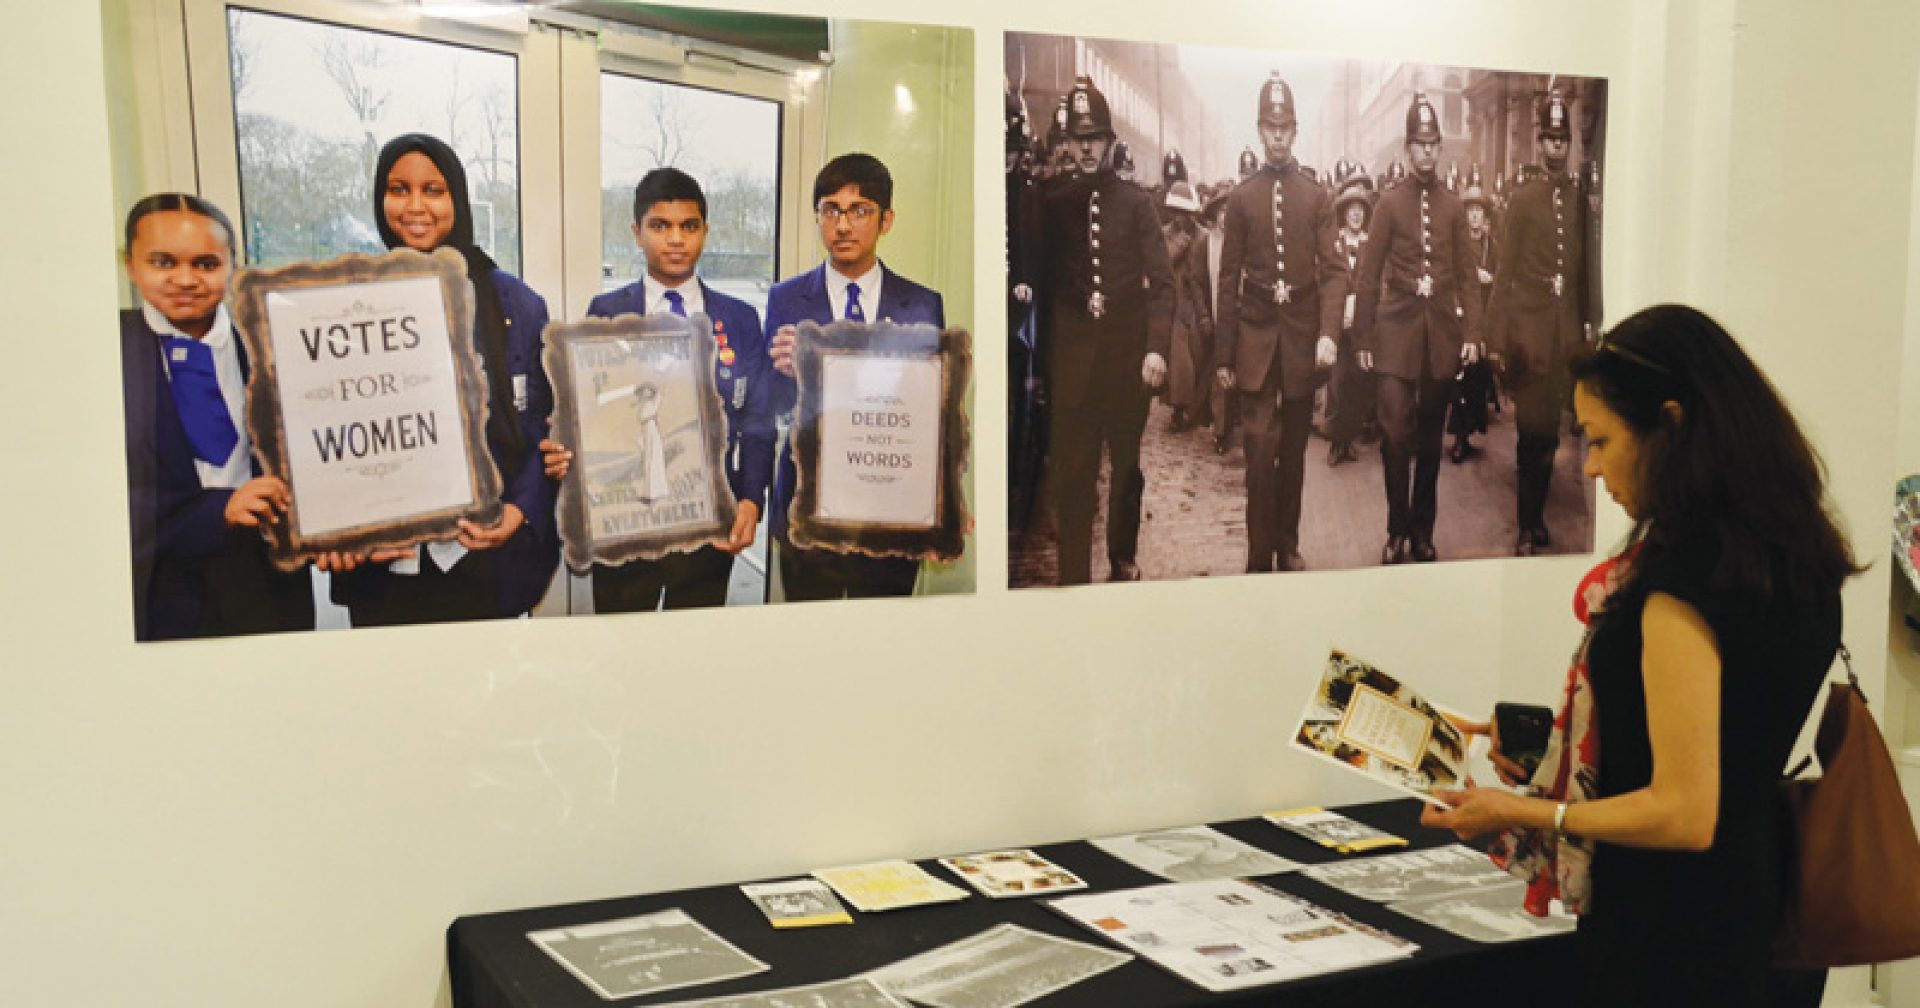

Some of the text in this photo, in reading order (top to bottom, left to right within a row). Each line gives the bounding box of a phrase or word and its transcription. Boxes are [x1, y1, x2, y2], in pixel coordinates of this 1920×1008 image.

[299, 316, 420, 362] VOTES
[339, 373, 399, 401] FOR
[851, 412, 911, 428] DEEDS
[312, 410, 438, 463] WOMEN
[866, 434, 893, 446] NOT
[846, 450, 913, 469] WORDS
